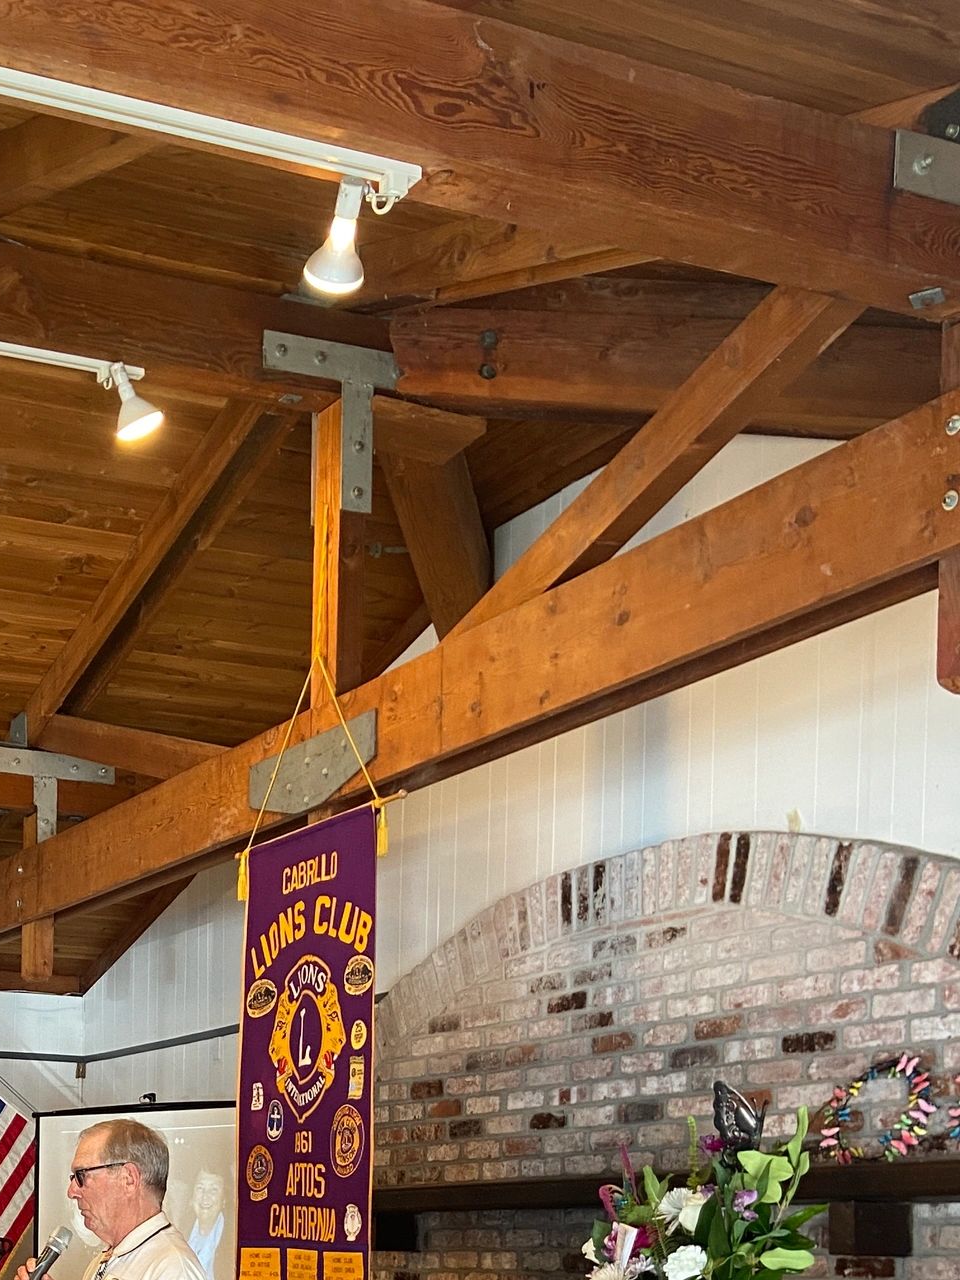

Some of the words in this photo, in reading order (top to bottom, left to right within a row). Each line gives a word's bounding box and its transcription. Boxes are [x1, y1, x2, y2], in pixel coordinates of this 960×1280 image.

[251, 900, 306, 979] LIONS
[313, 895, 373, 953] CLUB
[289, 964, 326, 999] LIONS
[298, 1008, 312, 1067] L
[286, 1163, 326, 1198] APTOS
[268, 1203, 337, 1243] CALIFORNIA
